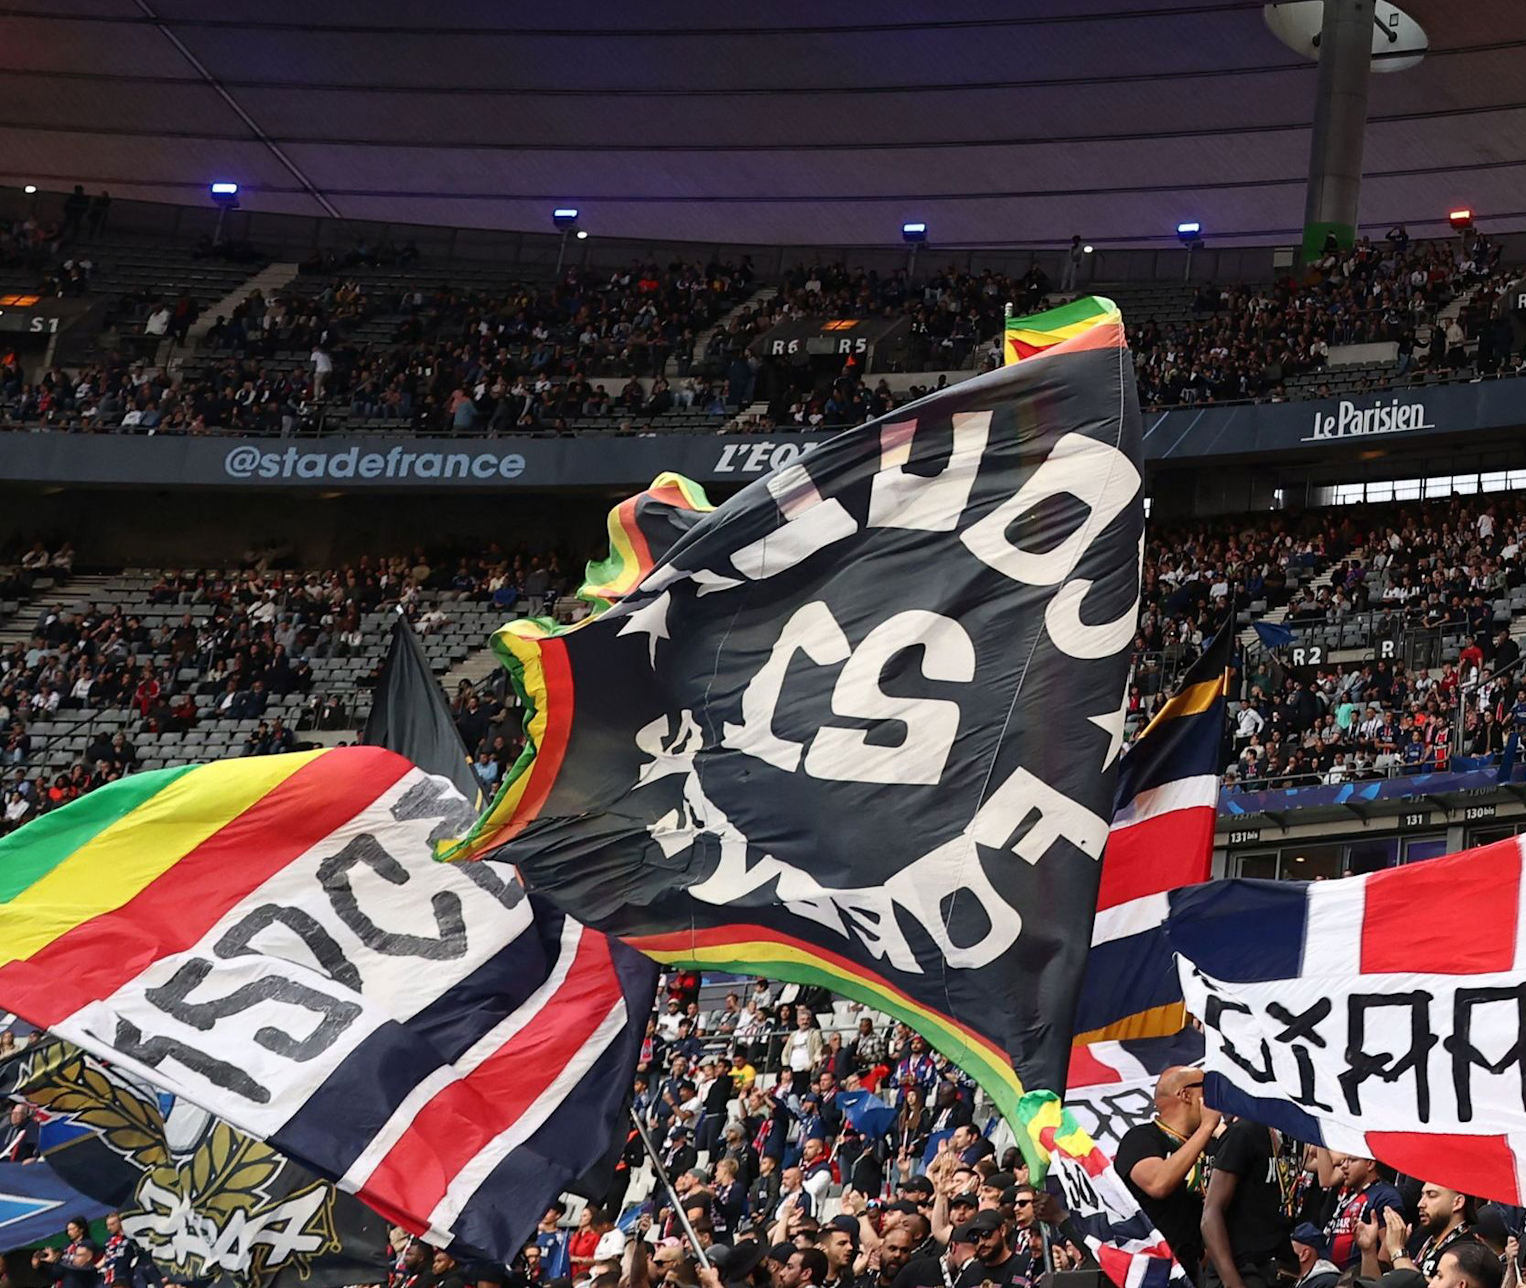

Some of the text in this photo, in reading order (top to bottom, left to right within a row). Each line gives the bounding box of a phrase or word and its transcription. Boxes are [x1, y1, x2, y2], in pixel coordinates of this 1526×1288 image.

[29, 316, 60, 334] S1
[771, 339, 800, 356] R6
[838, 337, 867, 354] R5
[1313, 398, 1425, 440] Le Parisien
[224, 446, 526, 479] @stadefrance
[1292, 646, 1322, 666] R2
[1405, 813, 1423, 825] 131
